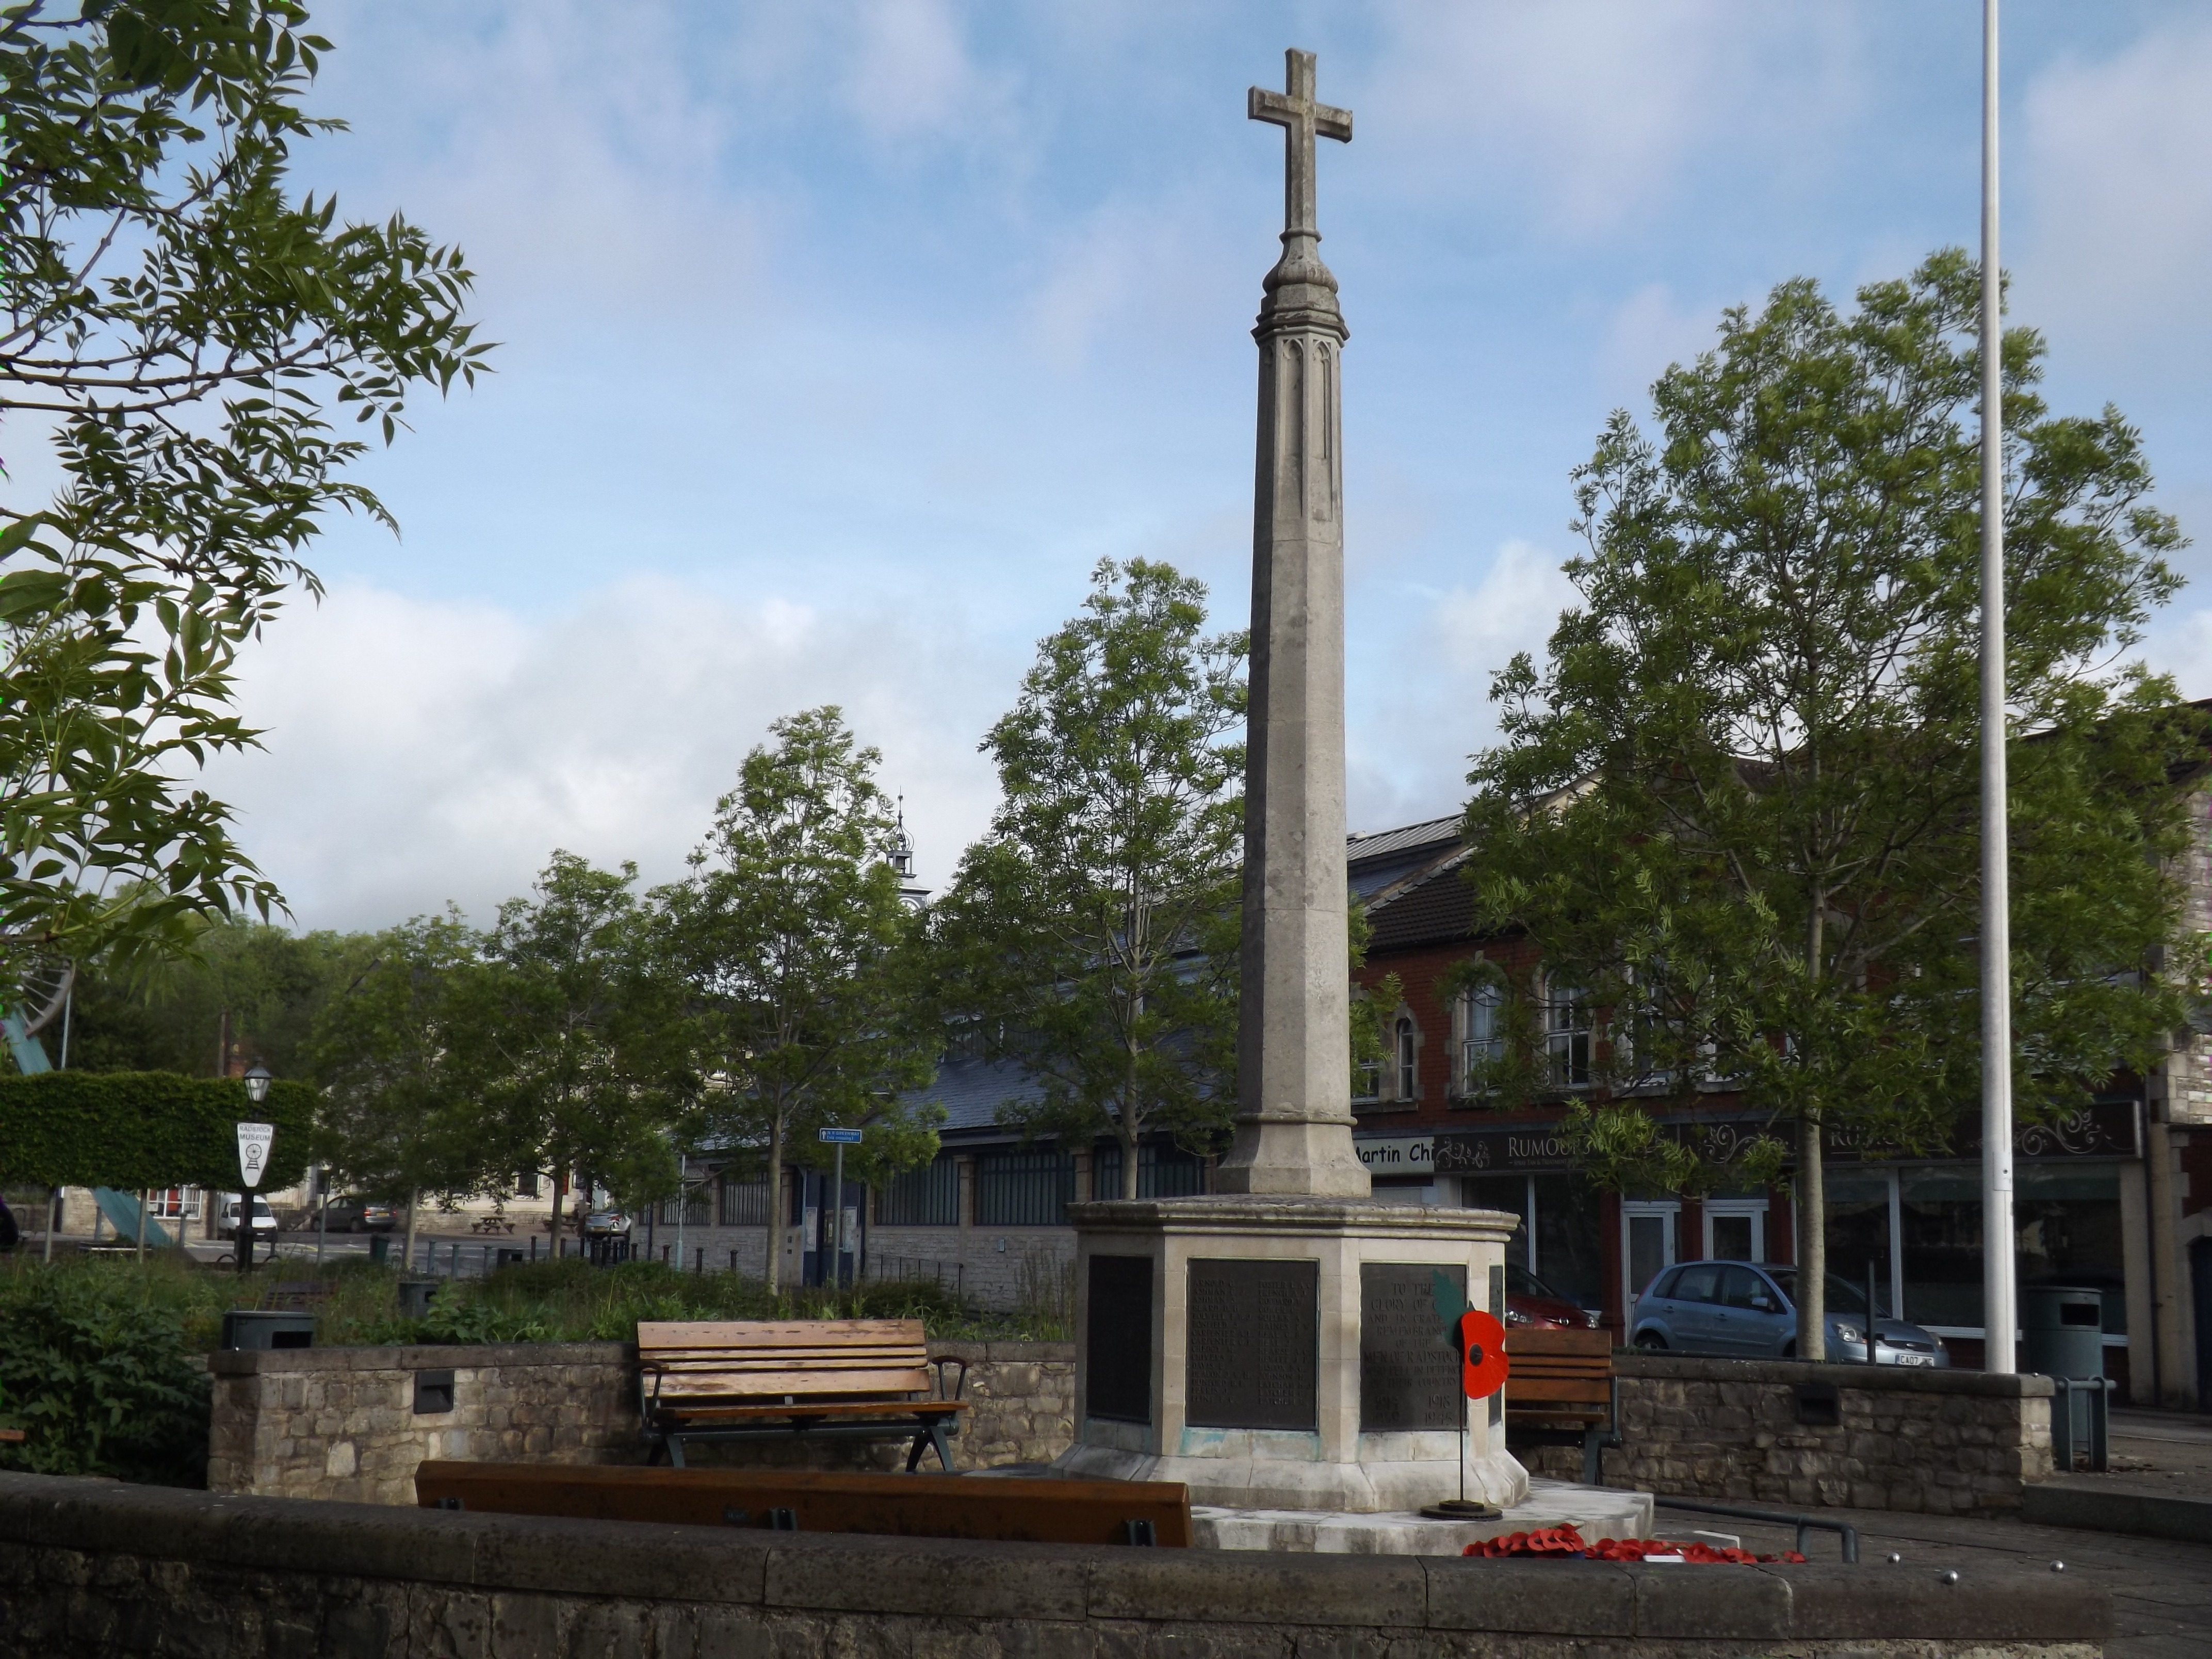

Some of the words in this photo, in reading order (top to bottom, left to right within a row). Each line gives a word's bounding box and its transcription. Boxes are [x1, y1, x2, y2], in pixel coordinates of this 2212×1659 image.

[1392, 1282, 1406, 1296] TO
[1412, 1282, 1435, 1296] THE
[1371, 1297, 1406, 1311] GLORY
[1413, 1298, 1427, 1311] OF
[1368, 1313, 1388, 1324] AND
[1396, 1313, 1407, 1324] IN
[1413, 1313, 1445, 1324] GRATE
[1396, 1339, 1407, 1348] OF
[1414, 1338, 1431, 1348] THE
[1364, 1350, 1387, 1363] MEN
[1391, 1350, 1405, 1363] OF
[1900, 1355, 1918, 1364] CA07
[1390, 1365, 1409, 1376] FELL
[1414, 1365, 1423, 1375] IN
[1427, 1365, 1460, 1375] DEFENC
[1418, 1376, 1456, 1387] COUNTRY
[1428, 1394, 1451, 1409] 1918
[1425, 1411, 1453, 1426] 1945
